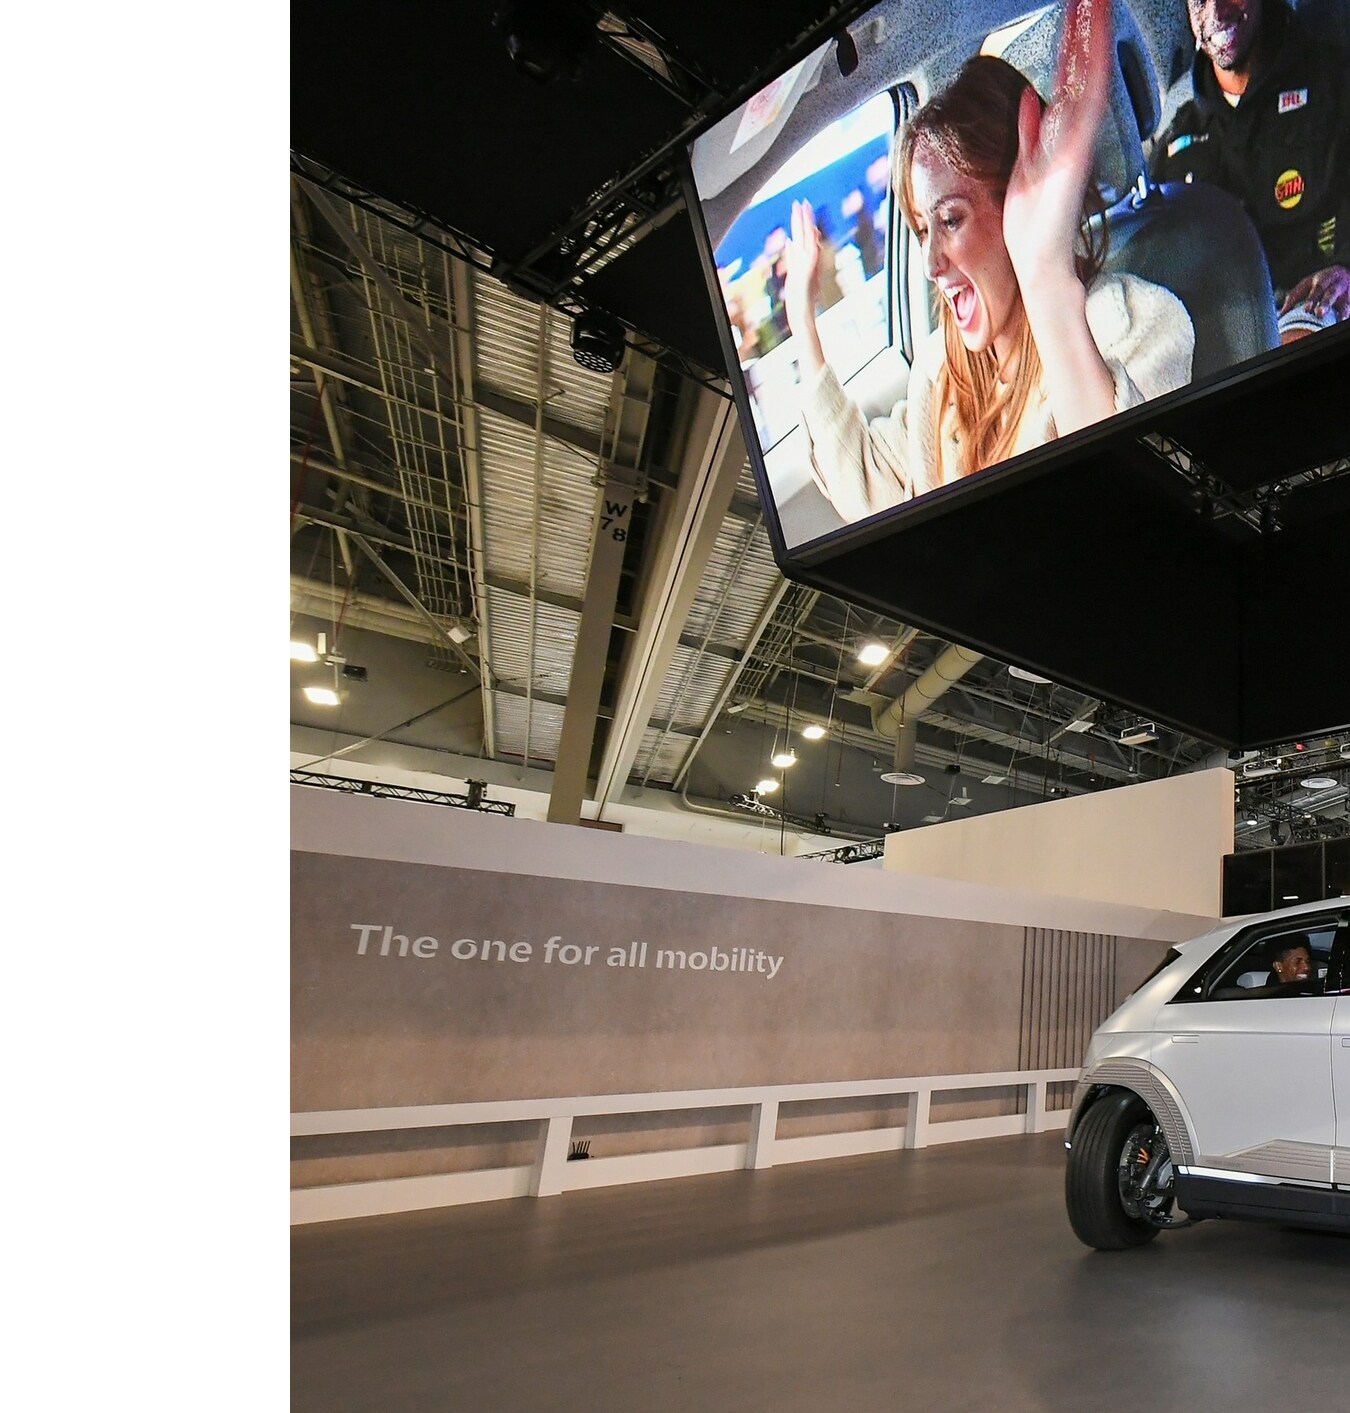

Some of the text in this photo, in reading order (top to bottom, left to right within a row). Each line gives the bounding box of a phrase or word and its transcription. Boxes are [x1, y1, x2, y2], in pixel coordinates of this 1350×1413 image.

[605, 500, 628, 517] W
[350, 923, 785, 980] The one for all mobility
